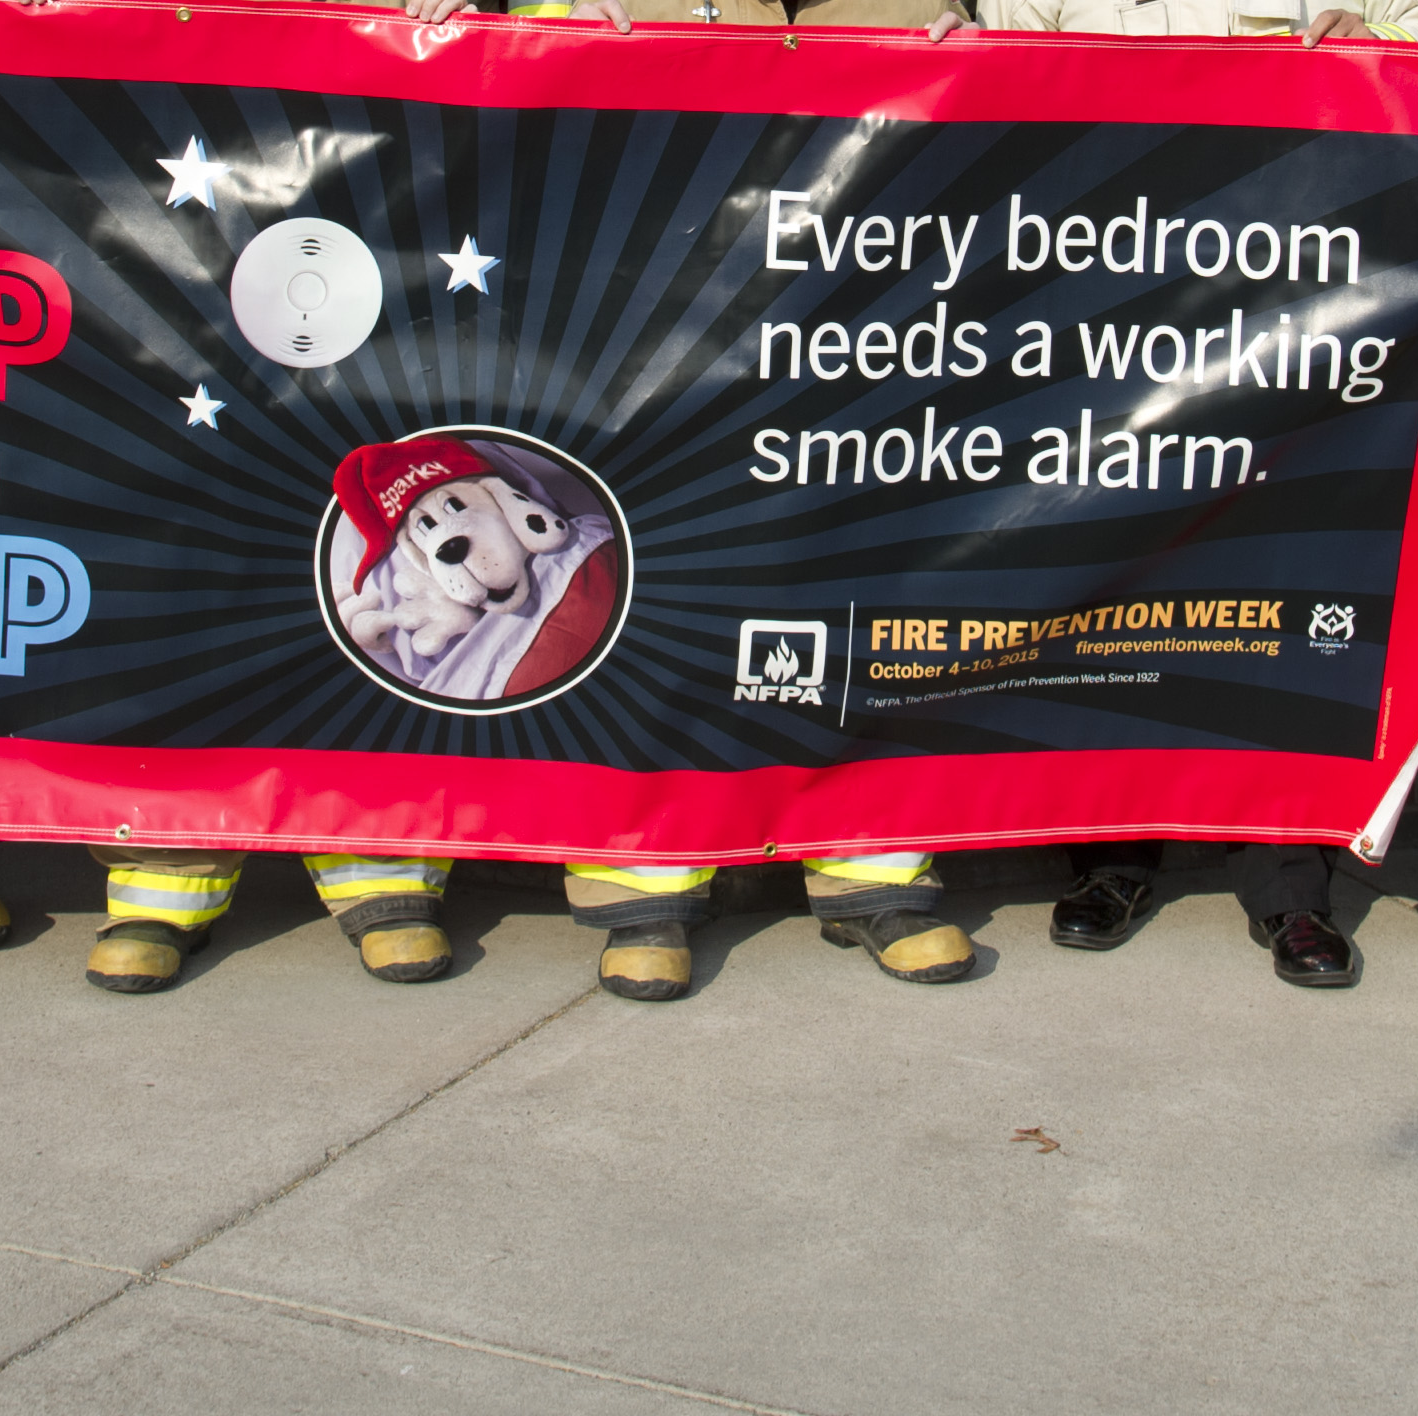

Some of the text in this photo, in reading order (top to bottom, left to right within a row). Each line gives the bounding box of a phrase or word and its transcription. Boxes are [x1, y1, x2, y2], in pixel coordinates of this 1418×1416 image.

[765, 189, 1360, 290] Every bedroom
[759, 302, 1395, 403] needs a working
[749, 406, 1268, 489] smoke alarm.
[379, 461, 451, 518] Sparky
[871, 601, 1283, 651] FIRE PREVENTION WEEK
[1075, 637, 1281, 656] firepreventionweek.org
[870, 662, 944, 679] October
[999, 648, 1039, 667] 2015
[905, 696, 922, 705] The
[924, 687, 957, 701] Official
[958, 683, 996, 697] Sponsor
[998, 680, 1008, 689] of
[1009, 679, 1027, 688] Fire
[1028, 674, 1079, 686] Prevention
[1081, 674, 1106, 684] Week
[1108, 673, 1134, 683] Since
[1136, 672, 1160, 682] 1922
[733, 685, 822, 706] NFPA
